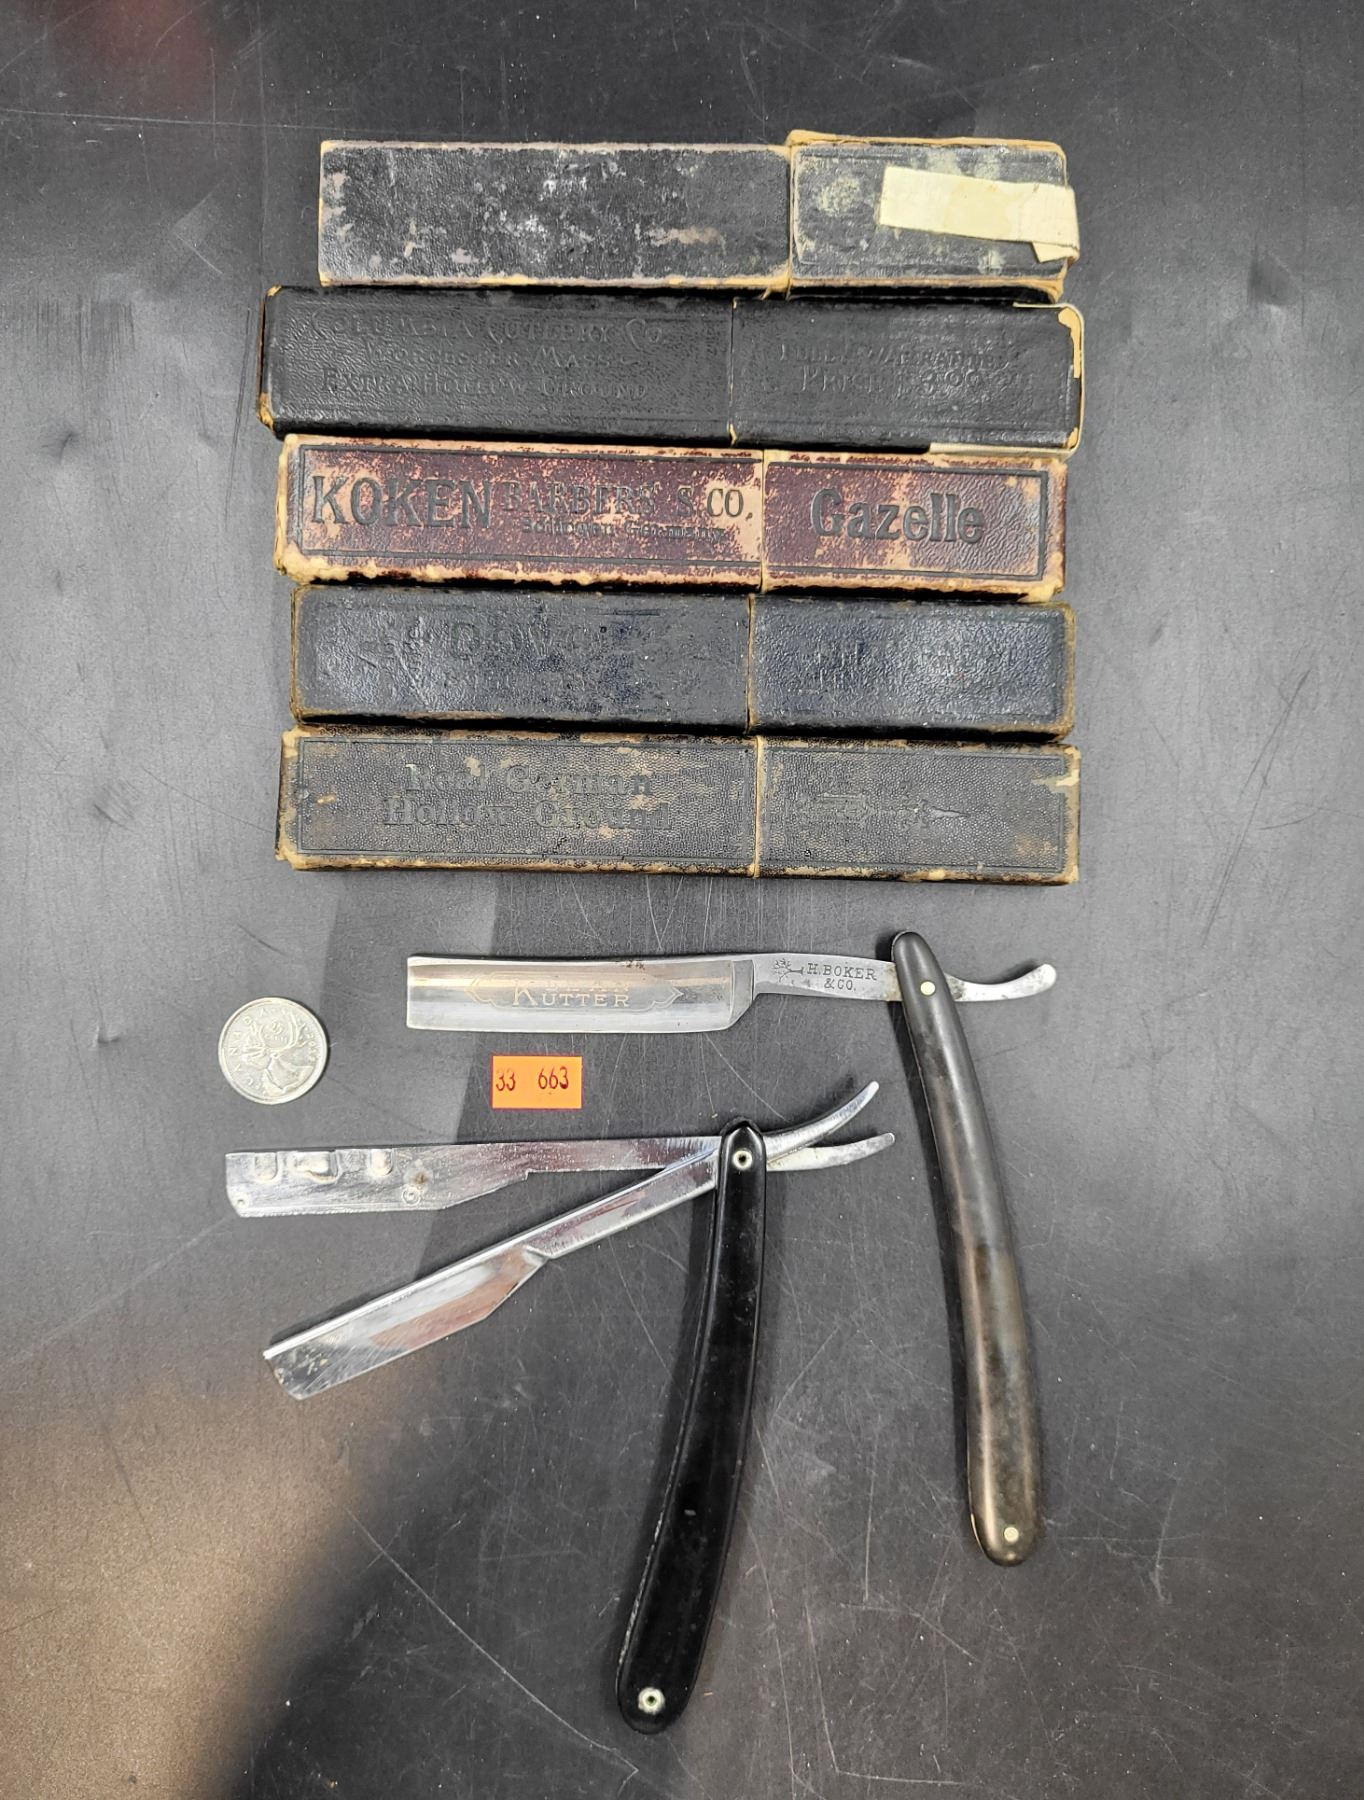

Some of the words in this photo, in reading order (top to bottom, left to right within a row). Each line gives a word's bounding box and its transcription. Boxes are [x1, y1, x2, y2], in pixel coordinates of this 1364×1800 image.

[313, 475, 492, 529] KOKEN
[811, 488, 984, 543] Gazelle
[506, 764, 653, 797] German
[534, 800, 672, 830] Ground
[511, 977, 631, 1008] KUTTER
[495, 1066, 516, 1092] 33
[537, 1065, 570, 1090] 663
